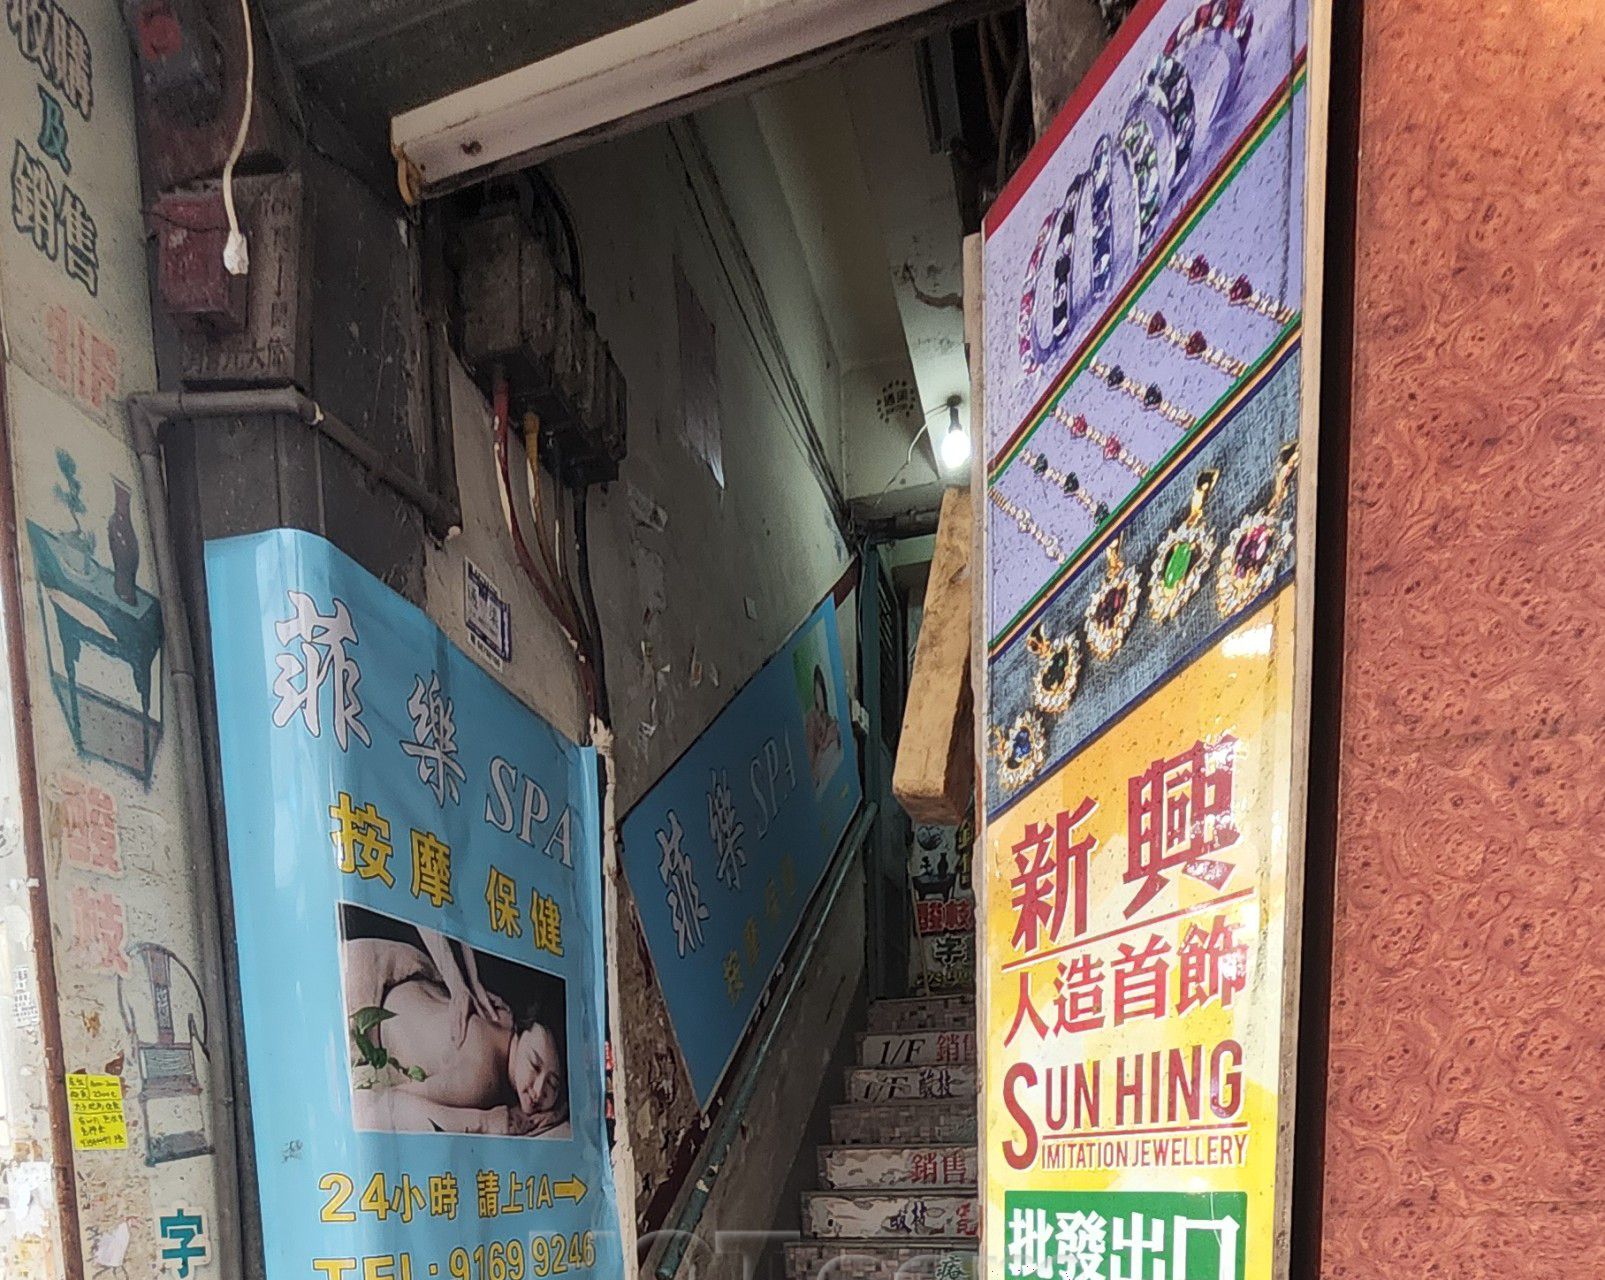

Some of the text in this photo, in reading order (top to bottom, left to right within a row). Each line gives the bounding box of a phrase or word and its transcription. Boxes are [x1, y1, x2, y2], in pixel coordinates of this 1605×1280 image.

[12, 139, 98, 298] 銷售
[485, 754, 574, 870] SPA
[1010, 735, 1240, 953] 新興
[329, 792, 564, 957] 按摩 保健
[1004, 915, 1249, 1047] 人造首飾
[879, 1038, 925, 1064] 1/F
[1002, 1039, 1243, 1170] SUN HING
[318, 1171, 458, 1224] 24小時
[1041, 1134, 1248, 1169] IMITATION JEWELLERY
[533, 1230, 595, 1278] 9246
